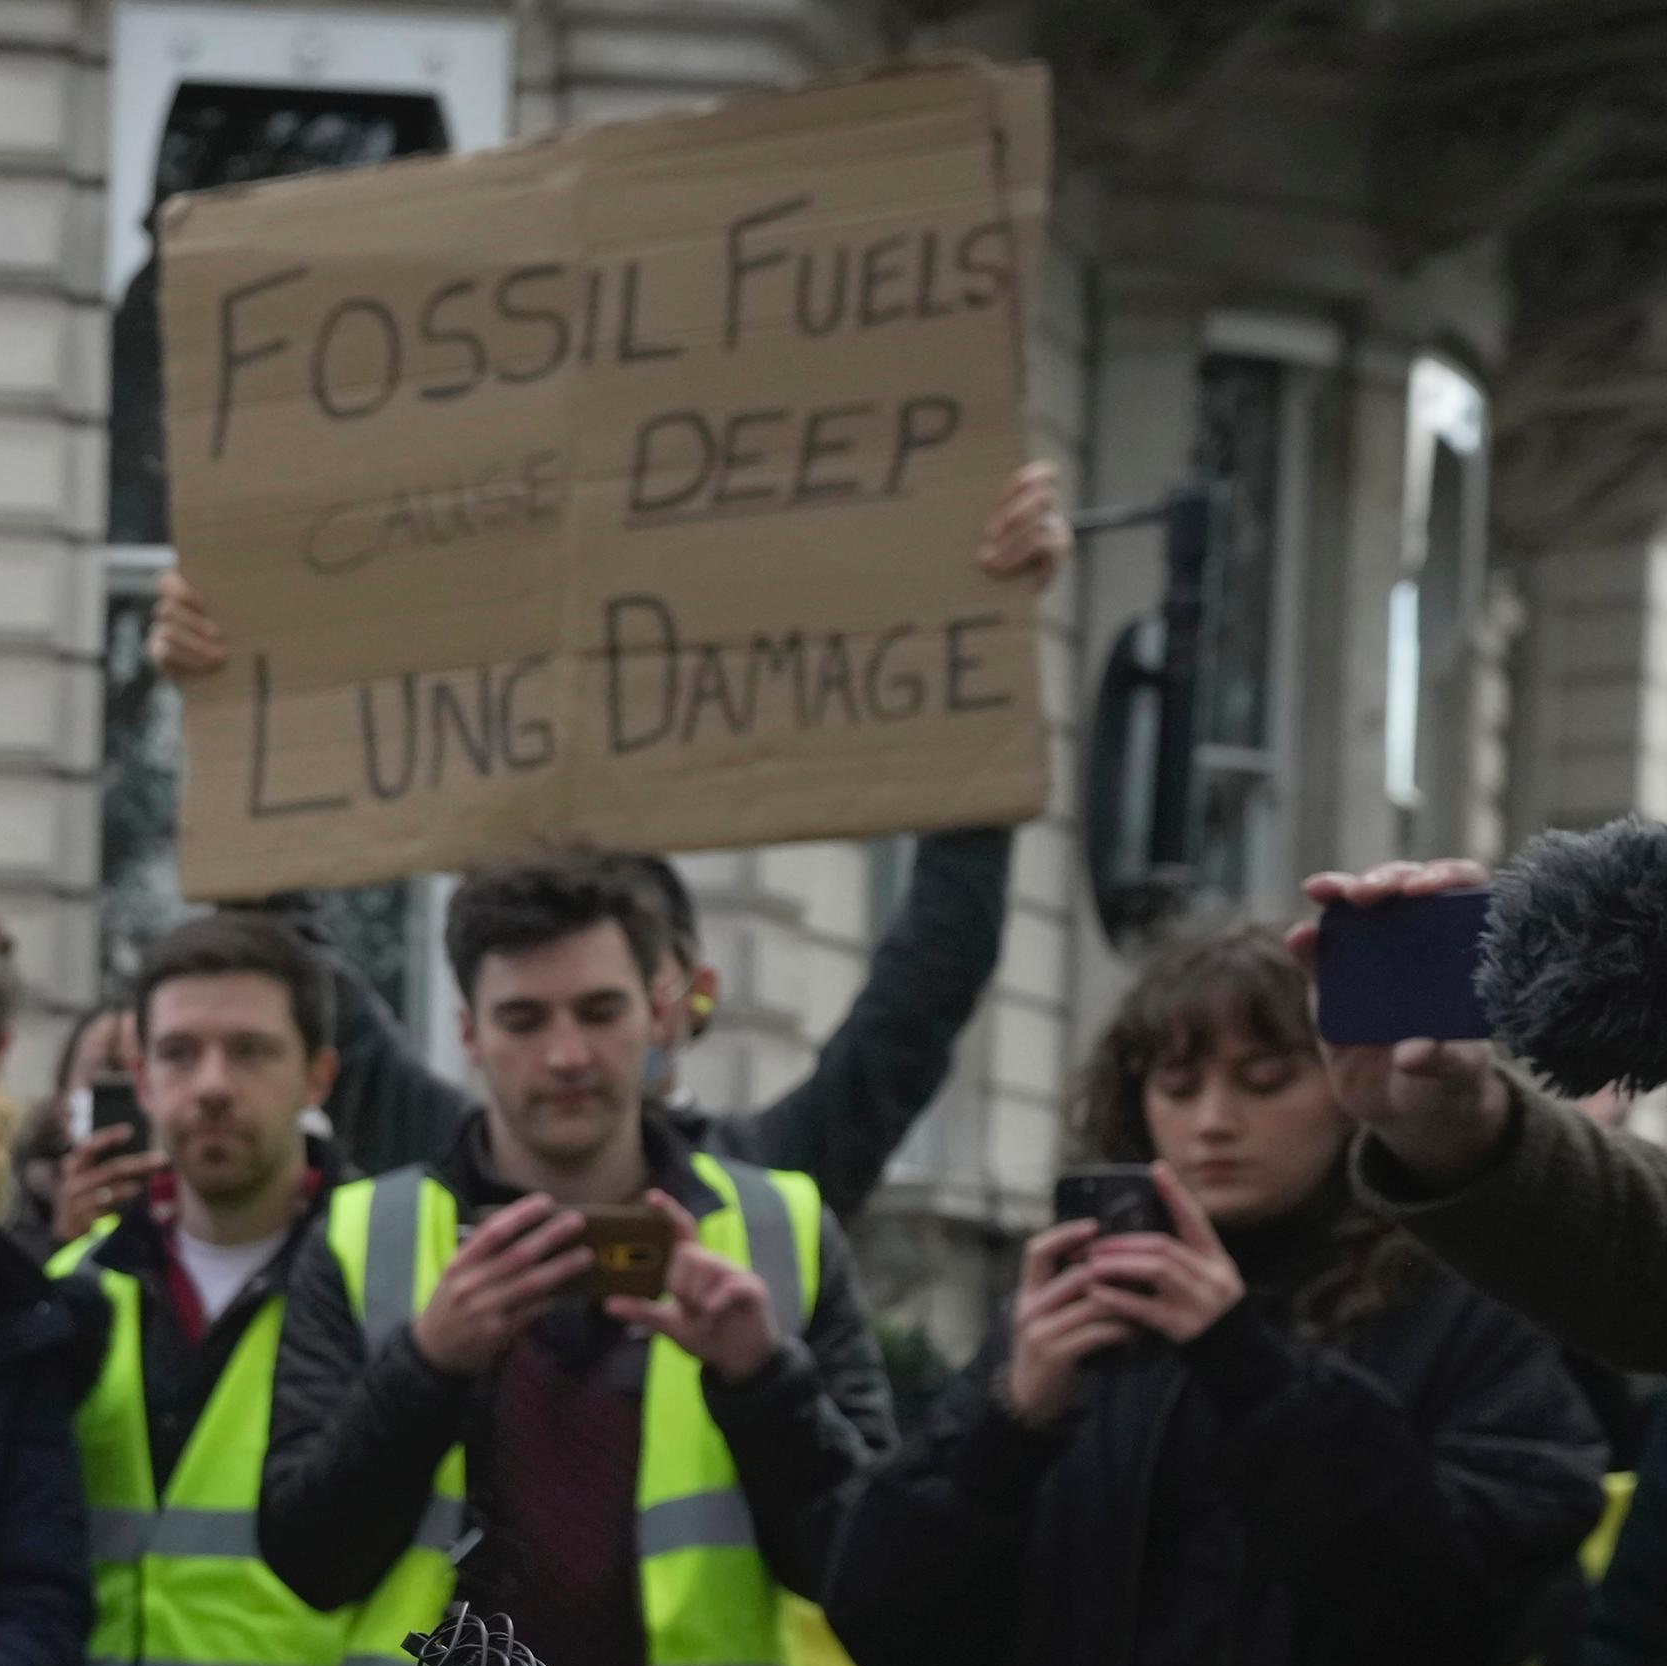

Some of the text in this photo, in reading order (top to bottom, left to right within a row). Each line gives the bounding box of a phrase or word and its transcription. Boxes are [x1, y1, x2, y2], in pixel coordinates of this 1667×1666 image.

[210, 196, 1010, 460] FOSSIL FUELS
[304, 396, 962, 575] CAUSE DEEP
[246, 594, 1012, 819] LUNG DAMAGE
